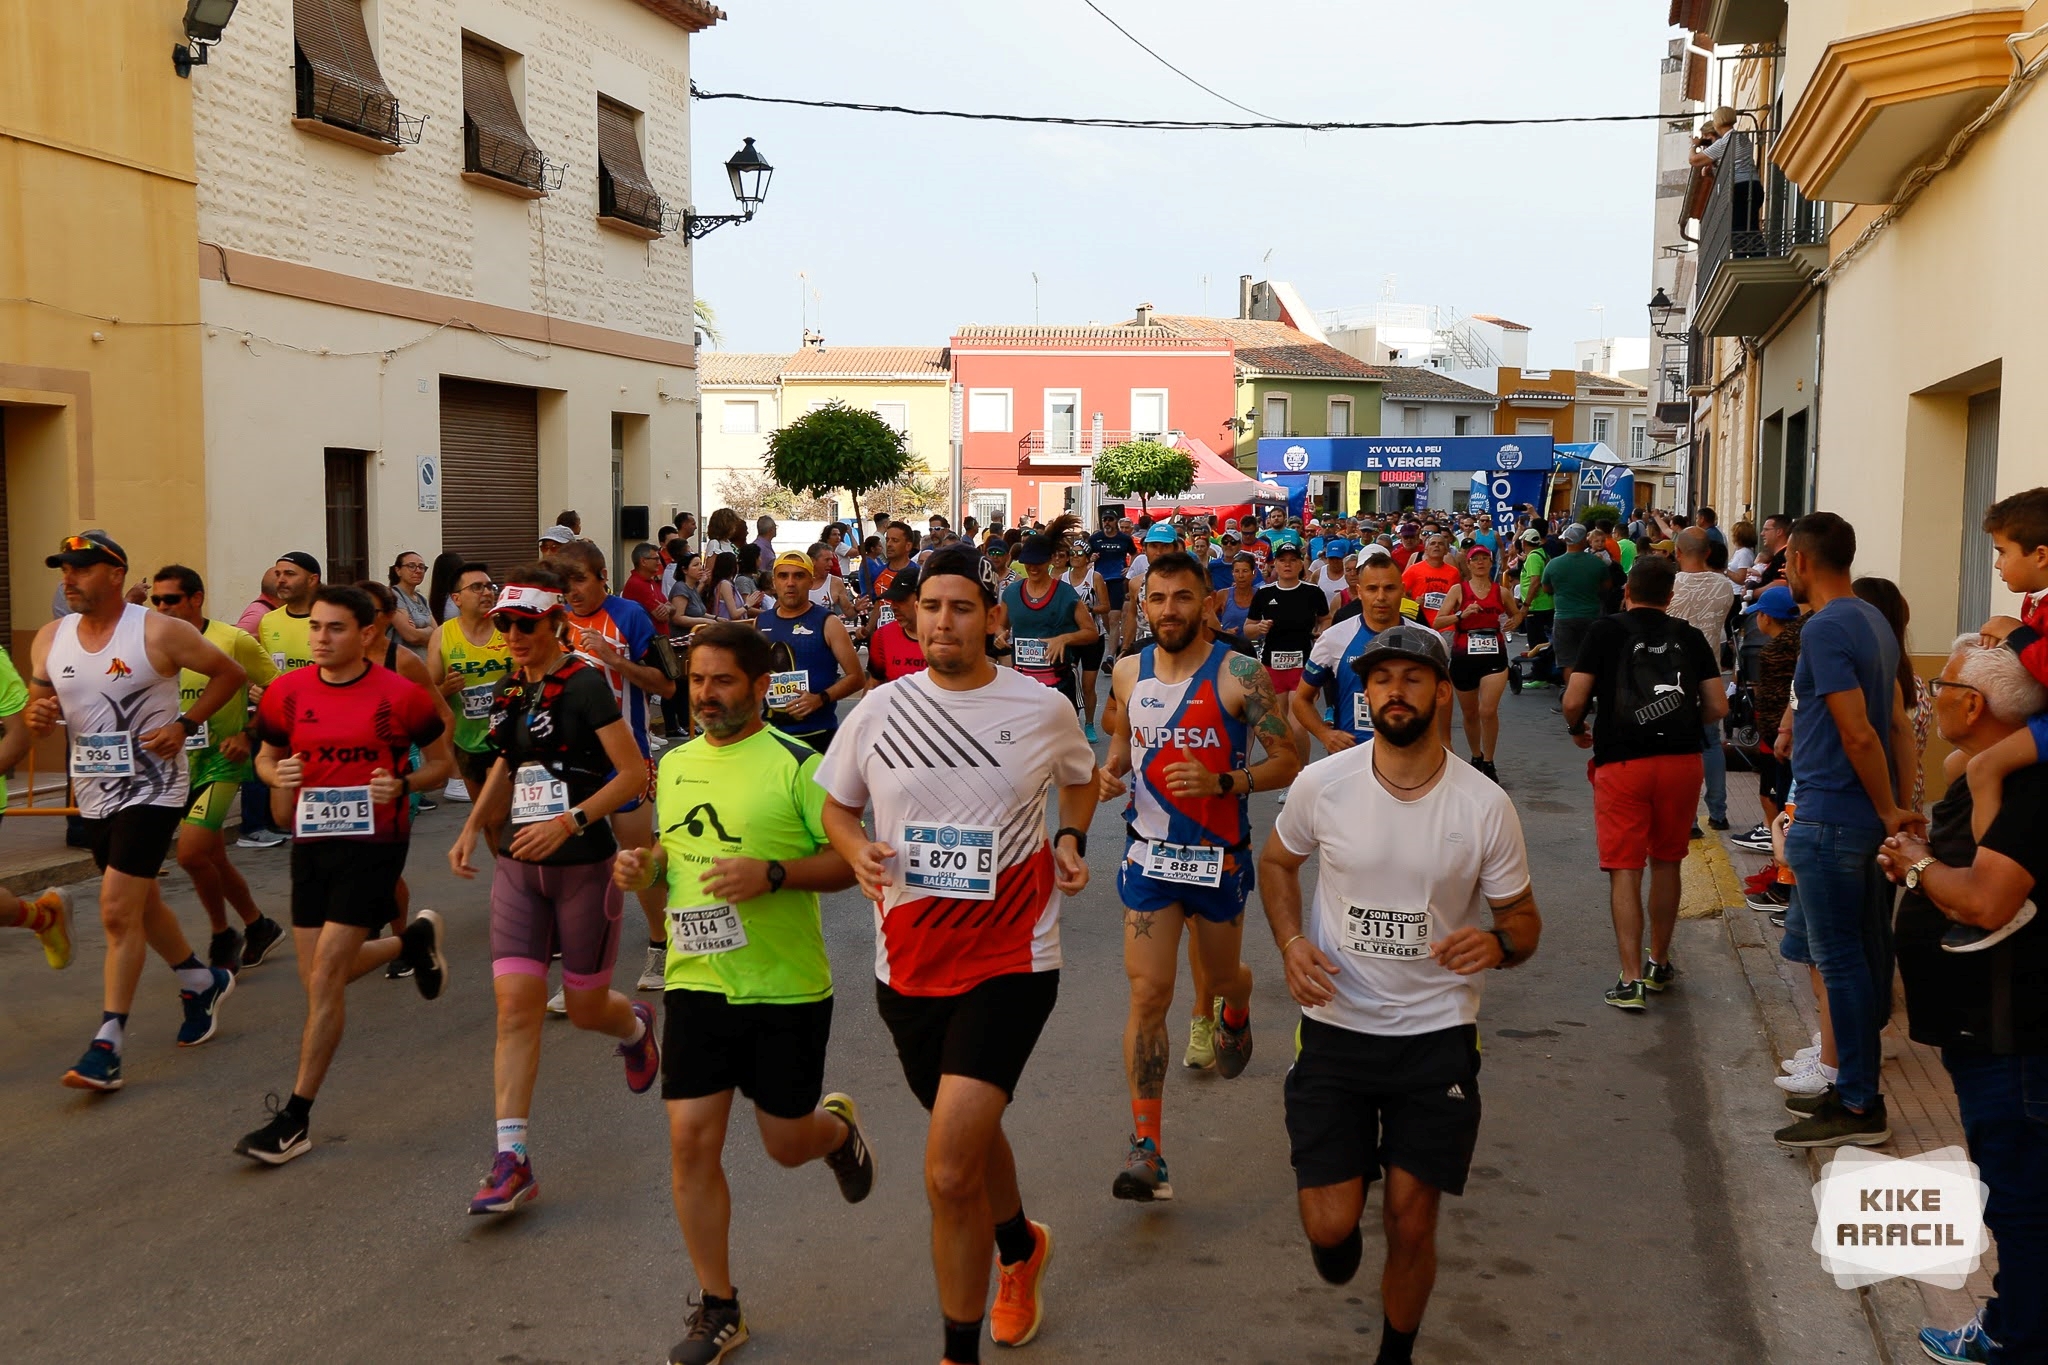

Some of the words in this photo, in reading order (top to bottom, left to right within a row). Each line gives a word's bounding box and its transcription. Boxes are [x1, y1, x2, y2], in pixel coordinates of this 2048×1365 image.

[1367, 457, 1382, 467] EL
[1387, 457, 1442, 467] VERGER
[1178, 491, 1205, 500] ESPORT
[905, 657, 929, 667] xar
[474, 696, 493, 706] 739
[1635, 691, 1681, 725] PUMA
[1132, 726, 1221, 749] ALPESA
[86, 750, 111, 761] 936
[120, 749, 128, 758] E
[521, 786, 543, 801] 157
[552, 784, 561, 796] C
[321, 806, 350, 818] 410
[360, 804, 368, 815] S
[929, 850, 967, 870] 870
[980, 853, 990, 869] S
[1170, 862, 1198, 872] 888
[1208, 864, 1217, 873] B
[923, 876, 969, 888] BALEARIA
[683, 911, 700, 920] SOM
[701, 906, 728, 919] ESPORT
[1369, 911, 1389, 920] SOM
[1393, 913, 1424, 923] ESPORT
[682, 920, 718, 937] 3164
[1361, 920, 1404, 939] 3151
[697, 939, 733, 950] VERGER
[1354, 942, 1367, 951] EL
[1372, 945, 1419, 956] VERGER
